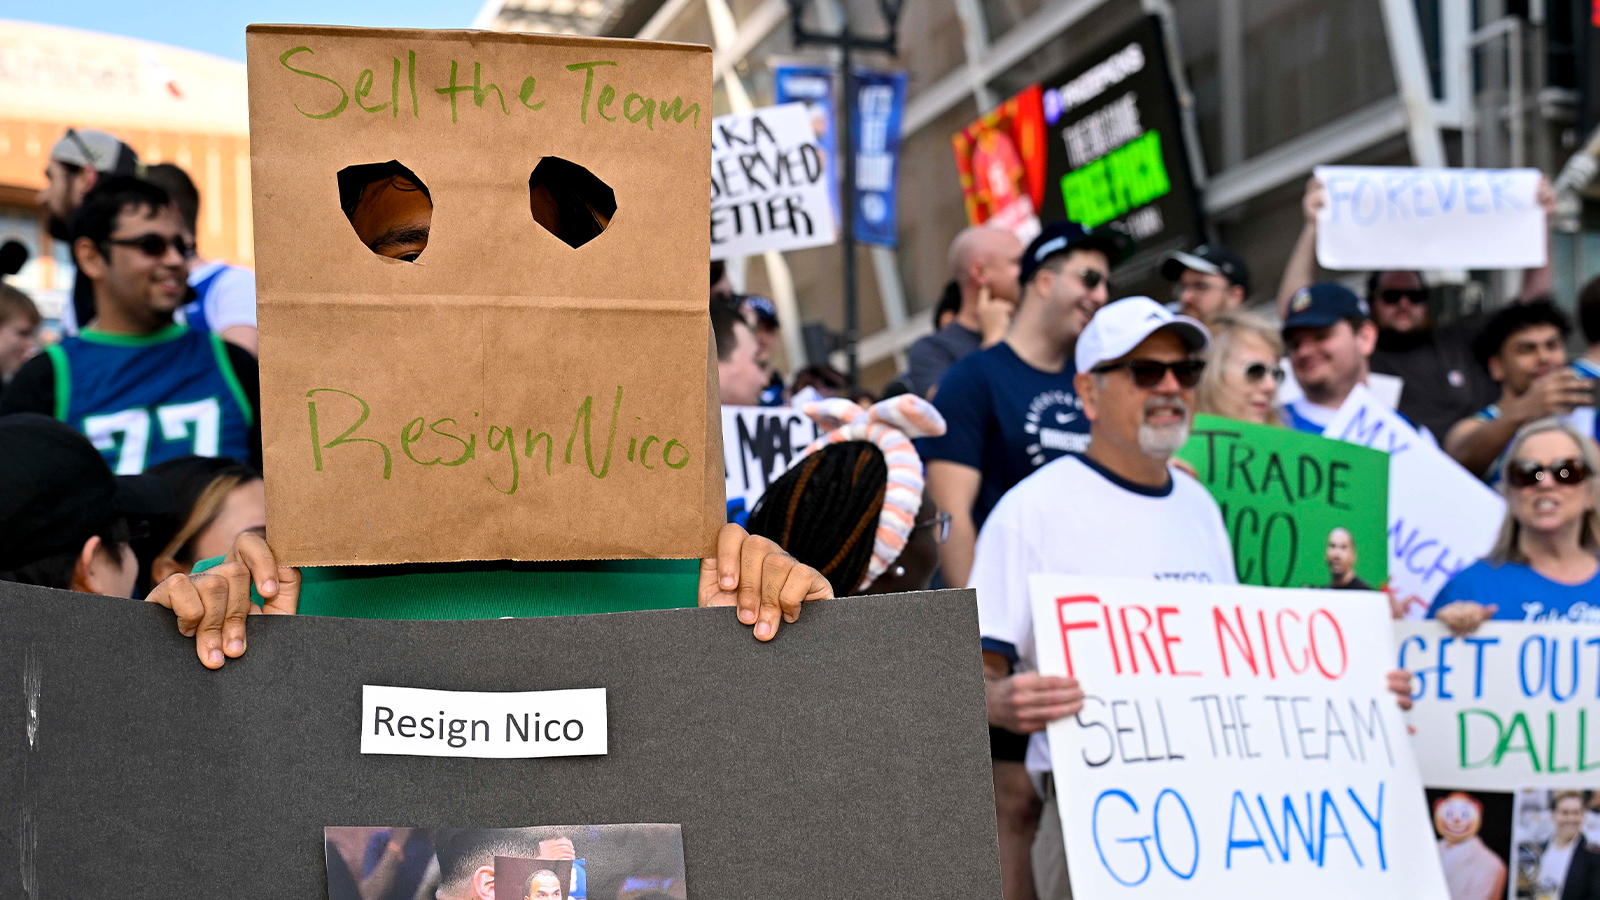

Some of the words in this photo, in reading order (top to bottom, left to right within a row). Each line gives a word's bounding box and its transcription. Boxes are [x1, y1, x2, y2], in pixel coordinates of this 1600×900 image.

[279, 46, 419, 119] Sell
[435, 59, 546, 124] the
[566, 60, 700, 130] Team
[712, 116, 776, 149] KA
[1326, 171, 1526, 228] FOREVER
[84, 397, 221, 476] 77
[306, 388, 554, 495] Resign
[565, 386, 690, 479] Nico
[1190, 429, 1352, 511] TRADE
[1055, 594, 1204, 679] FIRE
[1212, 605, 1348, 681] NICO
[1398, 634, 1500, 702] GET
[374, 706, 490, 748] Resign
[506, 712, 584, 742] Nico
[1075, 695, 1186, 768] SELL
[1190, 694, 1262, 760] THE
[1264, 694, 1396, 768] TEAM
[1457, 706, 1600, 774] DALL
[1092, 788, 1200, 887] GO
[1225, 780, 1387, 871] AWAY
